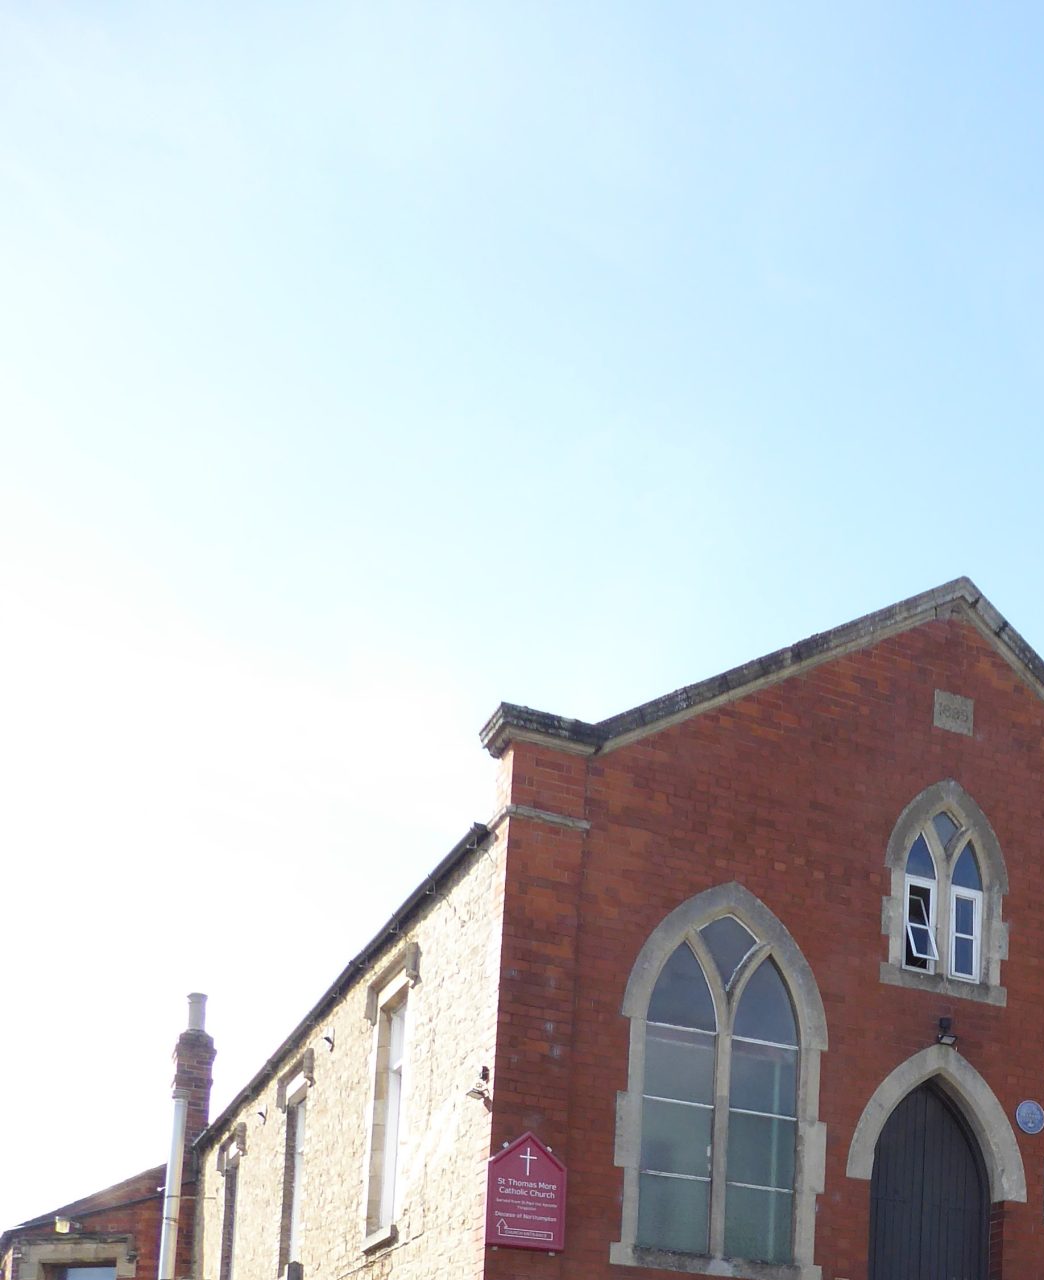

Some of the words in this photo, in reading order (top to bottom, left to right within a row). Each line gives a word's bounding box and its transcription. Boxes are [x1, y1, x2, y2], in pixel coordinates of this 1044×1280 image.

[498, 1177, 505, 1185] St
[508, 1178, 537, 1188] Thomas
[539, 1182, 557, 1191] More
[499, 1186, 528, 1196] Catholic
[530, 1189, 555, 1199] Church
[495, 1210, 515, 1218] Diocese
[523, 1213, 557, 1222] Northampton
